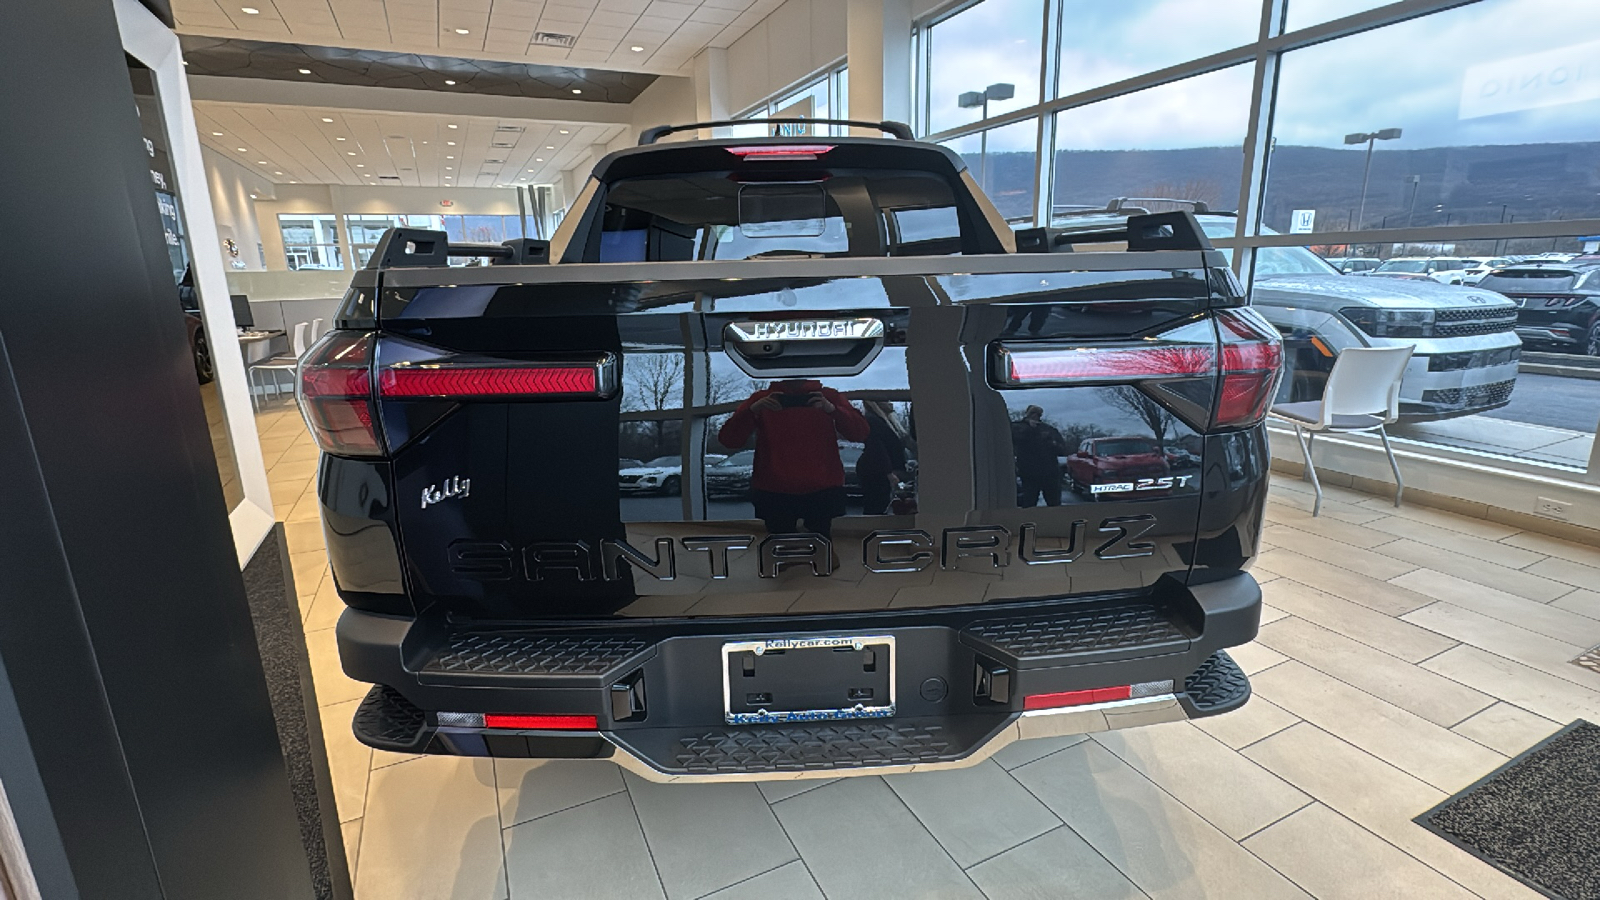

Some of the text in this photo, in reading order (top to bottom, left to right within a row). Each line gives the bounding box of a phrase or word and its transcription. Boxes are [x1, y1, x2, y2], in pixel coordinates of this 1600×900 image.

[756, 321, 854, 338] HYUNDAI
[421, 475, 470, 508] Kelly
[447, 513, 1157, 582] SANTA CRUZ
[765, 638, 853, 649] Kellycar.com
[786, 711, 828, 721] Auto
